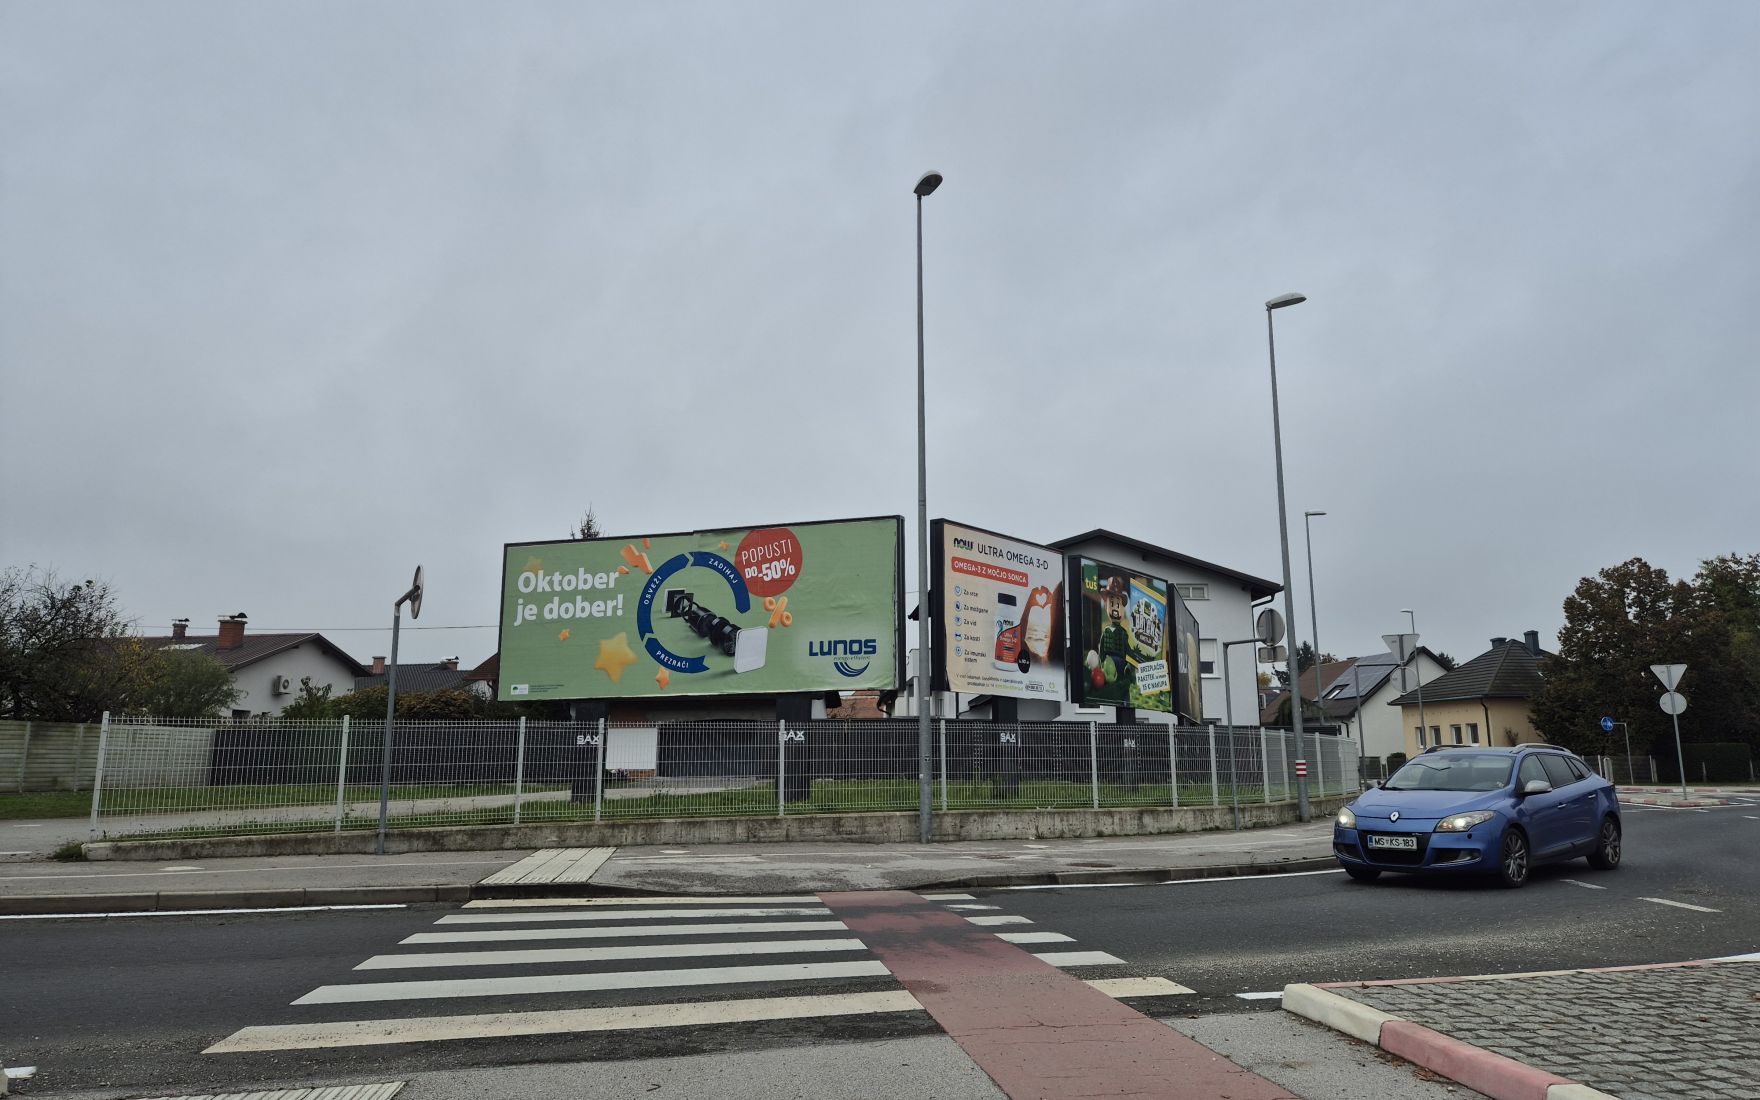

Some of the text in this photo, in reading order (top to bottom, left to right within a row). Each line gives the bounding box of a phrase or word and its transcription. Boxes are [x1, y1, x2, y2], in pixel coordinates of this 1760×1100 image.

[741, 538, 792, 565] POPUSTI
[977, 543, 1005, 559] ULTRA
[1006, 551, 1035, 568] OMEGA
[1036, 558, 1049, 570] 3-D
[517, 567, 620, 593] Oktober
[708, 558, 738, 584] ZADIHAJ
[745, 558, 796, 581] DO -50%
[954, 560, 981, 573] OMEGA-3
[982, 566, 987, 575] Z
[1008, 572, 1027, 583] SONCA
[643, 575, 662, 605] OSVEŽI
[513, 593, 624, 627] je dober!
[808, 638, 877, 656] LUNOS
[655, 650, 689, 669] PREZRAČI
[576, 733, 600, 745] SAX
[1000, 731, 1016, 743] SAX
[1374, 837, 1415, 848] MS KS-183
